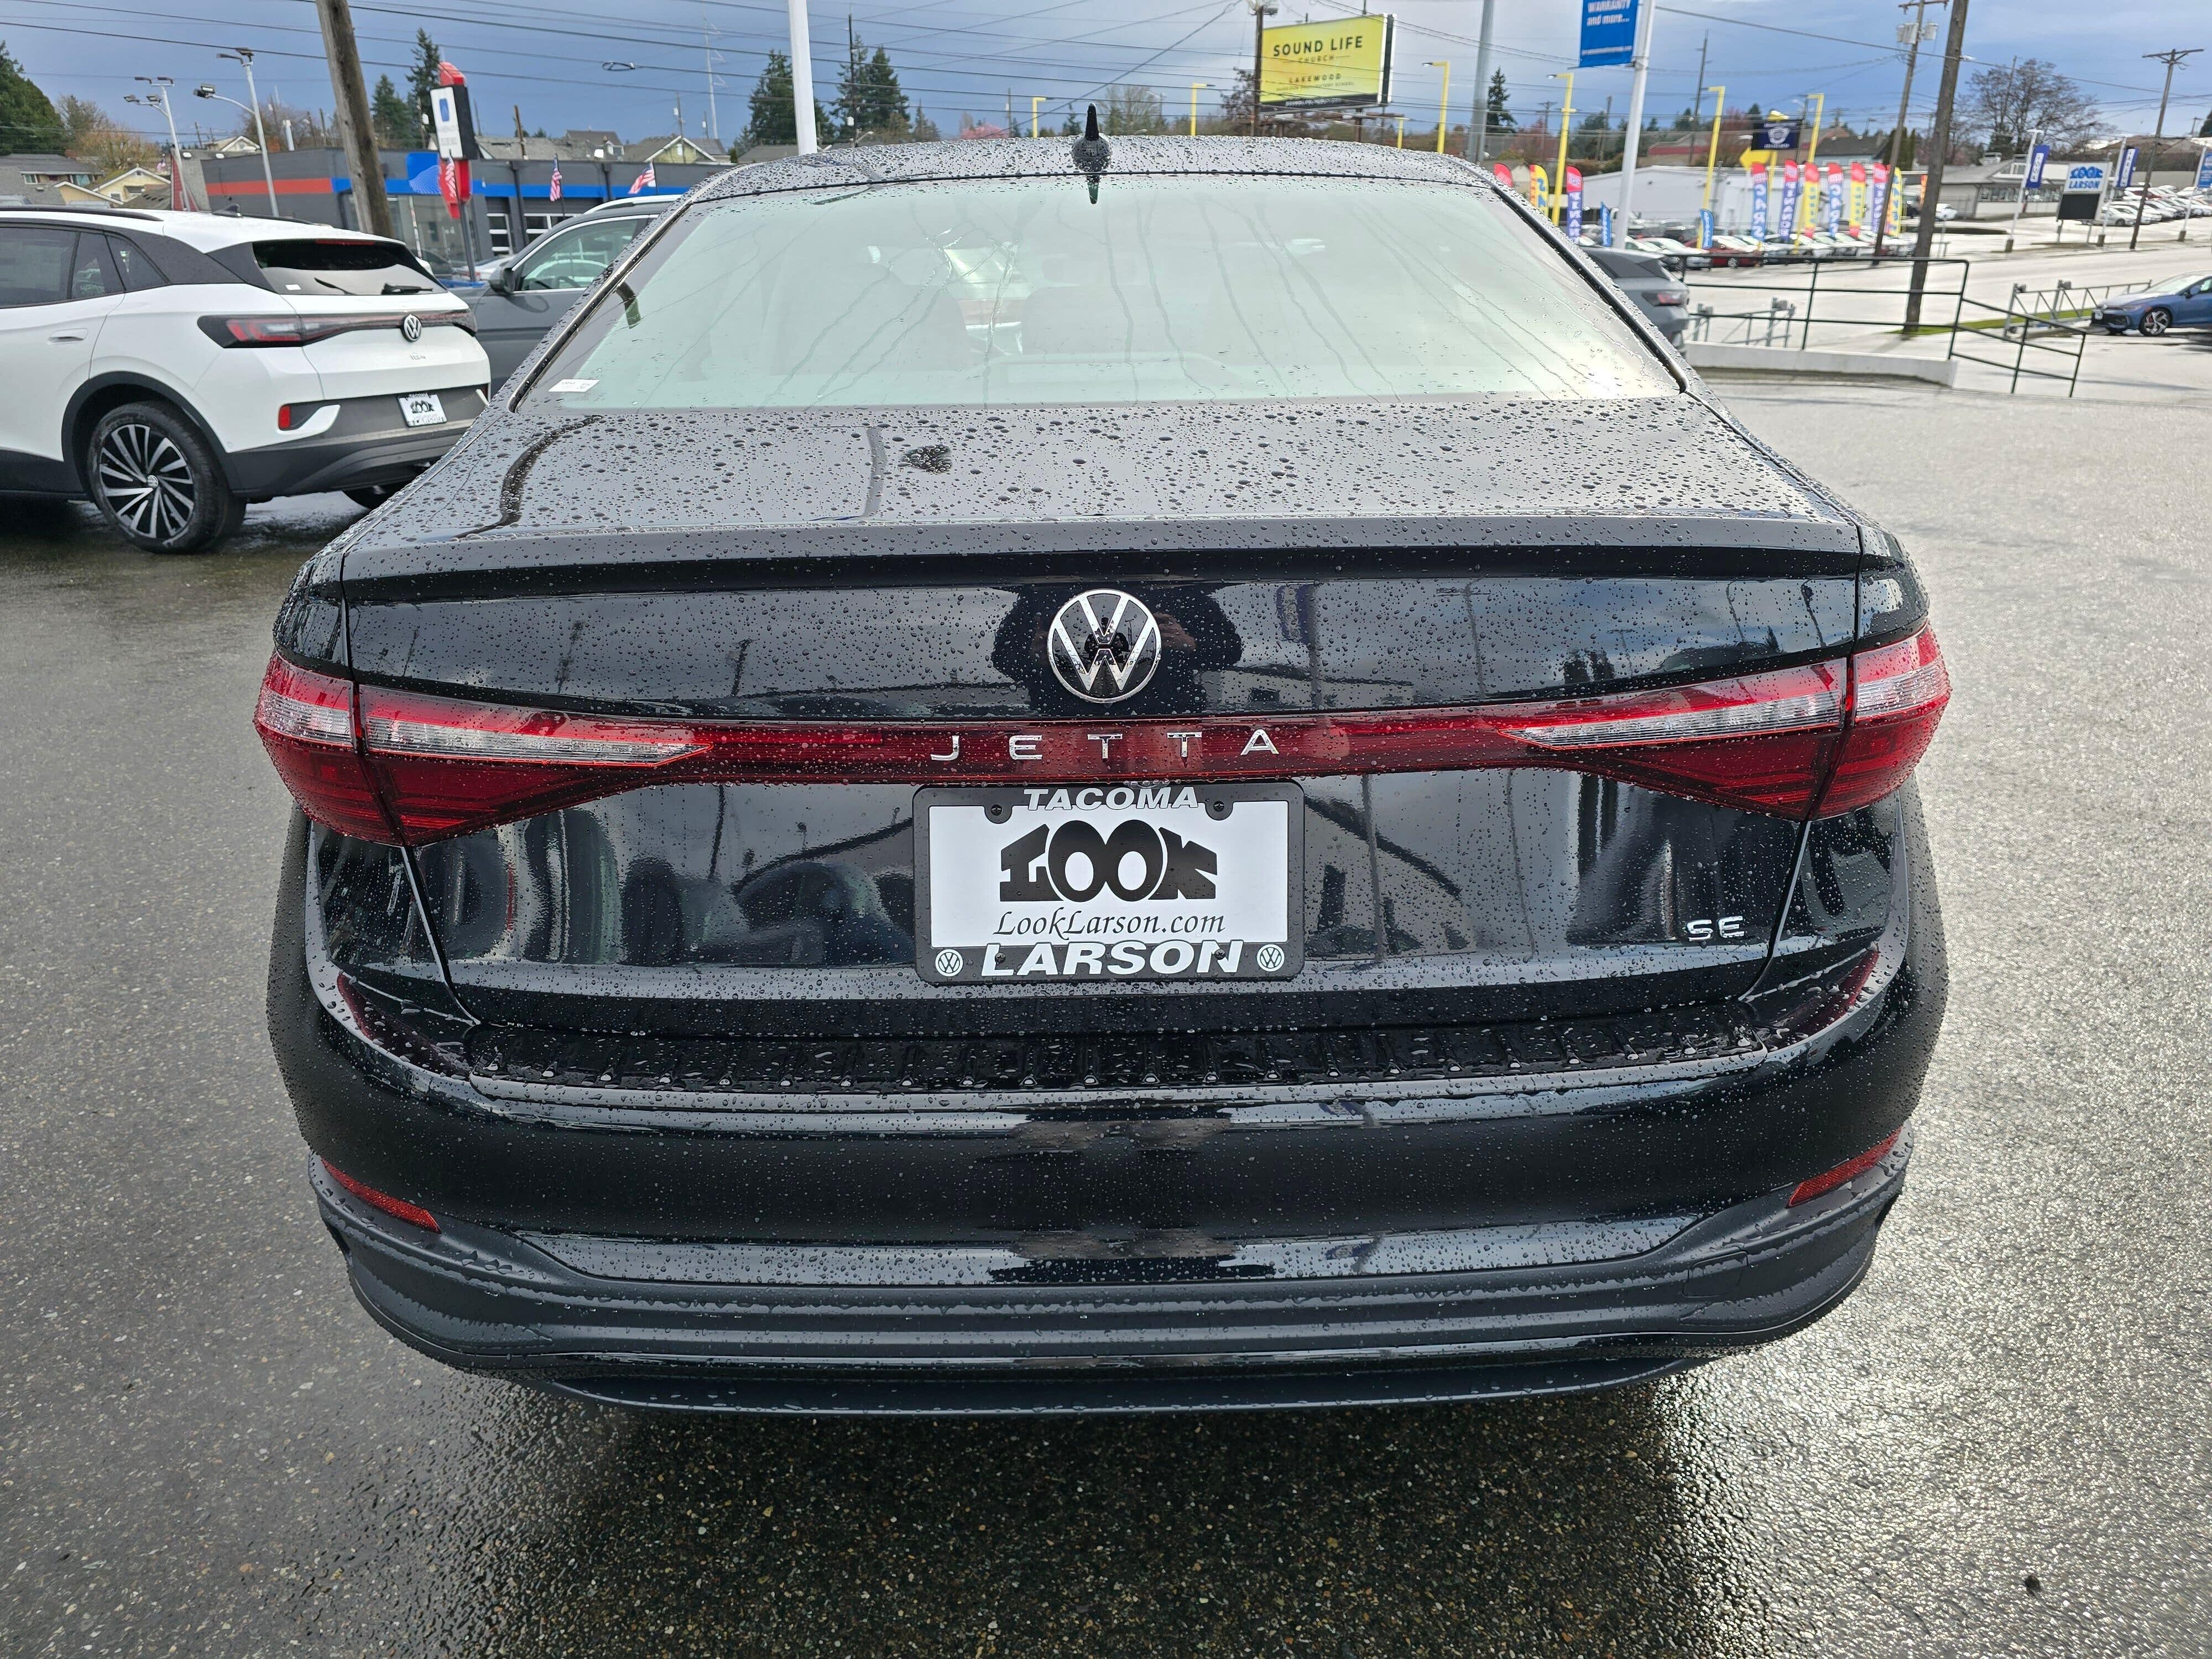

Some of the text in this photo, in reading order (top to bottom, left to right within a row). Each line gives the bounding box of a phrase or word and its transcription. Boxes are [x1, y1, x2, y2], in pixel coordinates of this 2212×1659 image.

[1587, 14, 1602, 27] and
[1274, 35, 1363, 56] SOUND LIFE
[1298, 54, 1334, 63] CHURCH
[1289, 72, 1342, 83] LAKEWOOD
[2069, 166, 2104, 179] LOOK
[2068, 180, 2100, 189] LARSON
[931, 729, 1279, 760] JETTA
[1023, 787, 1199, 811] TACOMA
[999, 820, 1218, 902] LOOK
[993, 906, 1227, 940] LookLarson.com
[1687, 915, 1744, 942] SE
[981, 940, 1244, 977] LARSON
